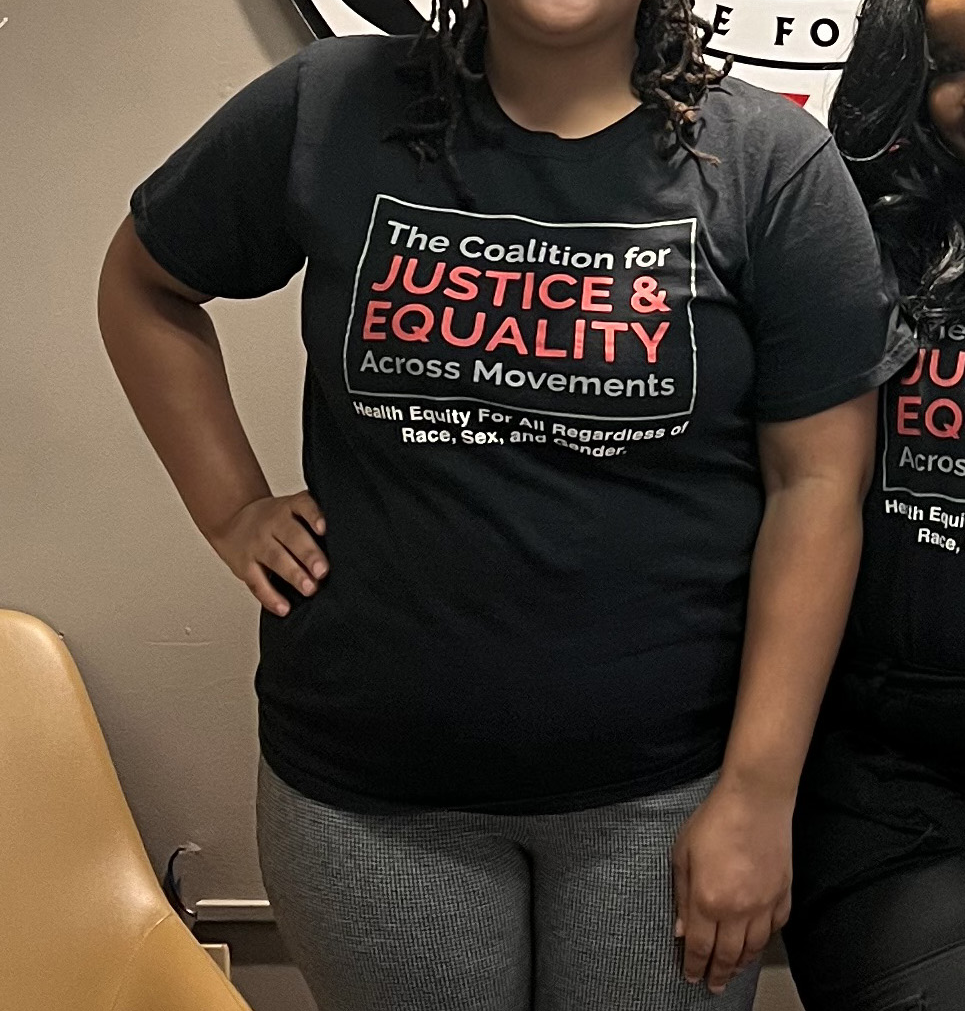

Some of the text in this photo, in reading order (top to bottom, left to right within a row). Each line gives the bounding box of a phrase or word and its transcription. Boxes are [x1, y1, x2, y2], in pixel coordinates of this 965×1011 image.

[774, 16, 839, 47] FO
[388, 220, 671, 269] The Coalition for
[371, 255, 672, 313] JUSTICE &
[362, 300, 670, 363] EQUALITY
[360, 350, 675, 397] Across Movements
[353, 400, 689, 442] Health Equity For All Regardless of
[402, 427, 457, 445] Race,
[462, 429, 505, 445] Sex,
[510, 430, 547, 443] and
[917, 527, 960, 554] Race,
